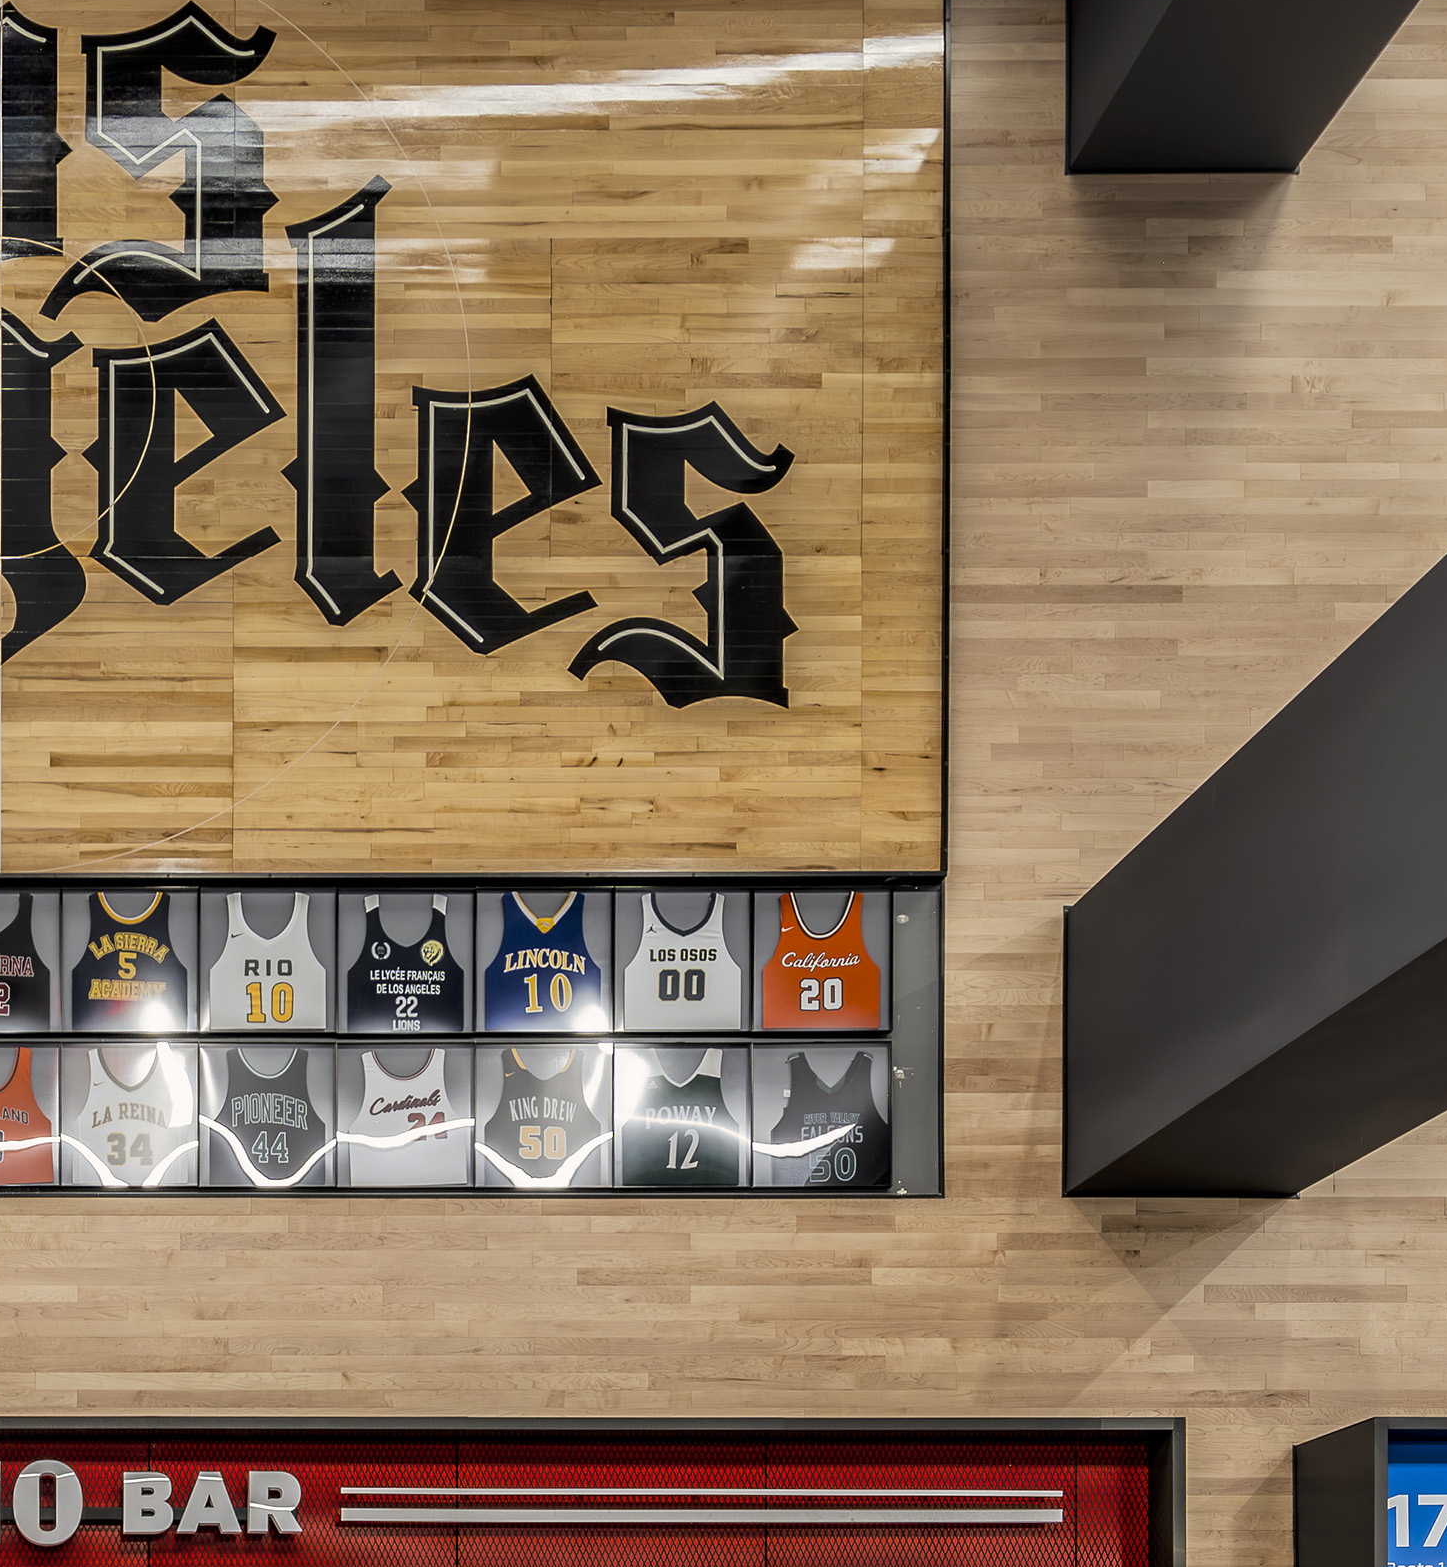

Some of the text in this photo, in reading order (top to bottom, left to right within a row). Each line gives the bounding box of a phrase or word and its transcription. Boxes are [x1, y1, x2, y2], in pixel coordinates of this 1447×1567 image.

[244, 958, 292, 976] RIO
[503, 948, 585, 976] LINCOLN
[649, 949, 717, 963] LOS OSOS
[780, 950, 860, 972] California
[659, 969, 705, 1001] 00
[799, 977, 843, 1011] 20
[245, 981, 294, 1024] 10
[509, 1096, 576, 1123] KING DREW
[122, 1471, 303, 1535] BAR
